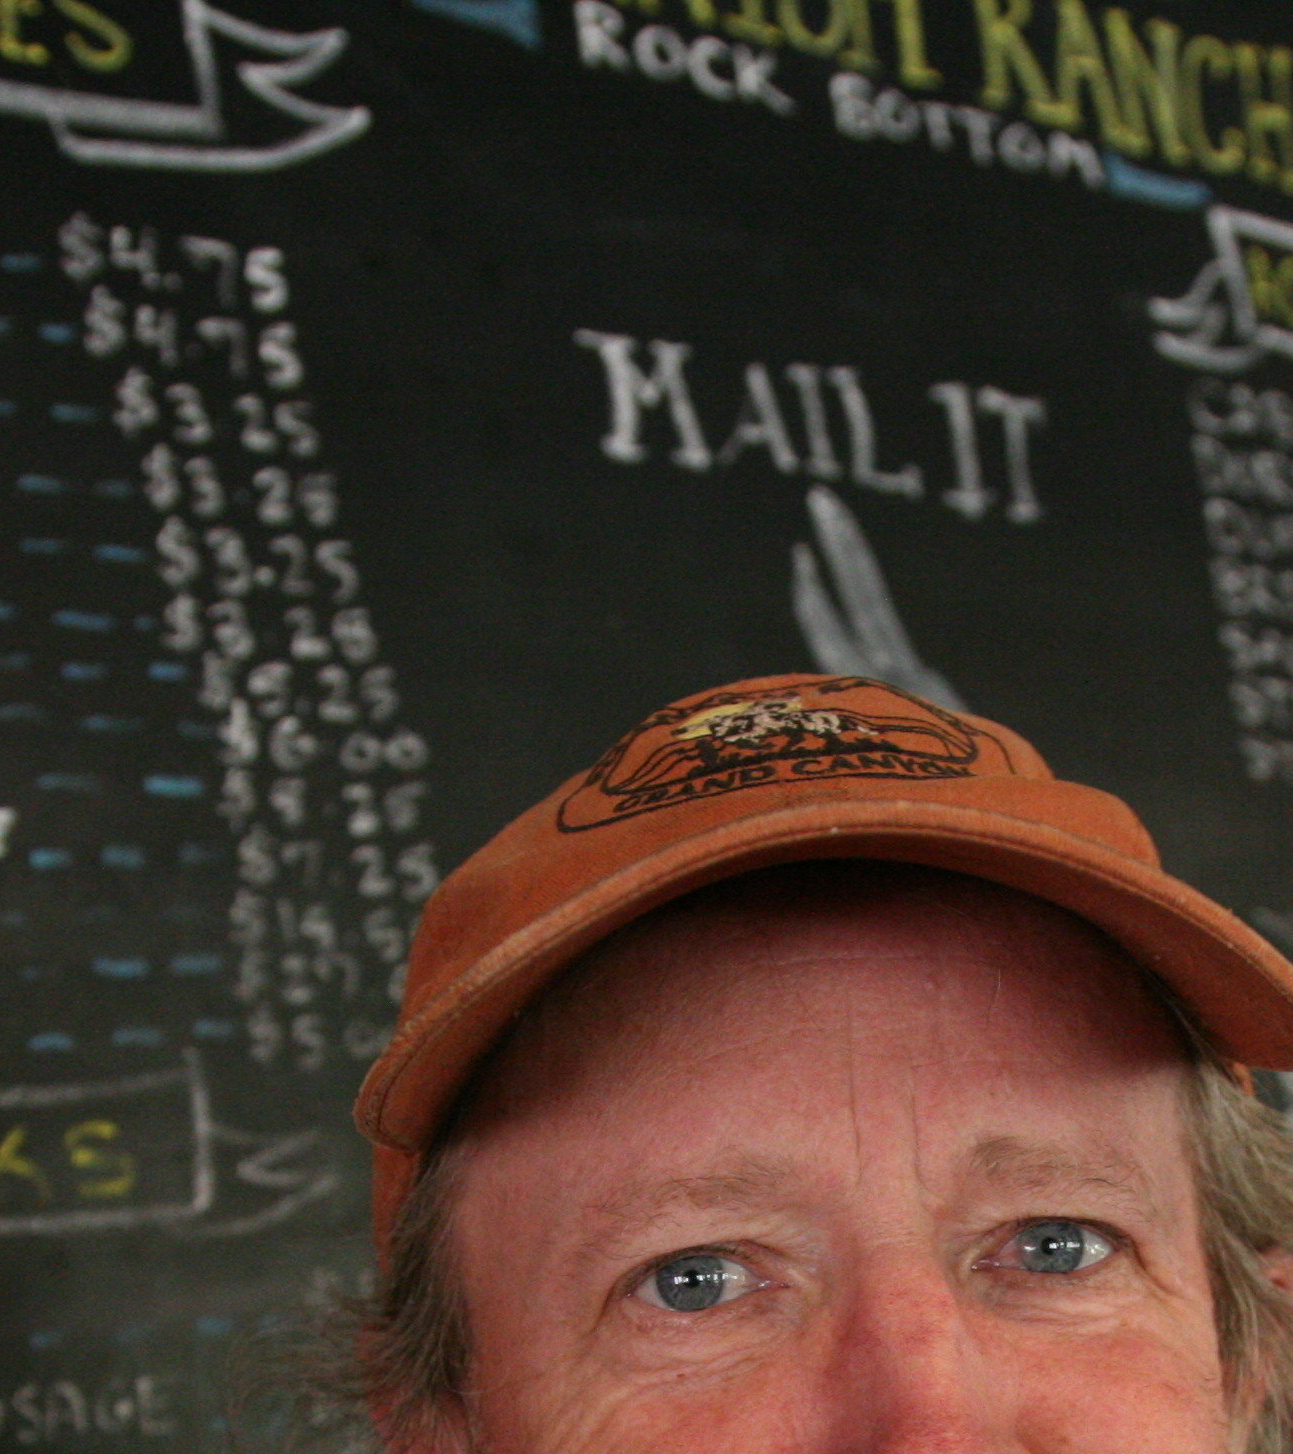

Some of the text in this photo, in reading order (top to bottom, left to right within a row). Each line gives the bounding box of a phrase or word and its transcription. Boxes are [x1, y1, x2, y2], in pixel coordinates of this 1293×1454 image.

[573, 0, 797, 115] ROCK
[828, 72, 1107, 190] BOTTOM
[56, 209, 290, 313] $4.75
[82, 284, 305, 390] $4.75
[572, 326, 1049, 525] MAIL IT
[156, 514, 360, 602] $3.25
[612, 752, 975, 814] GRAND CANYON
